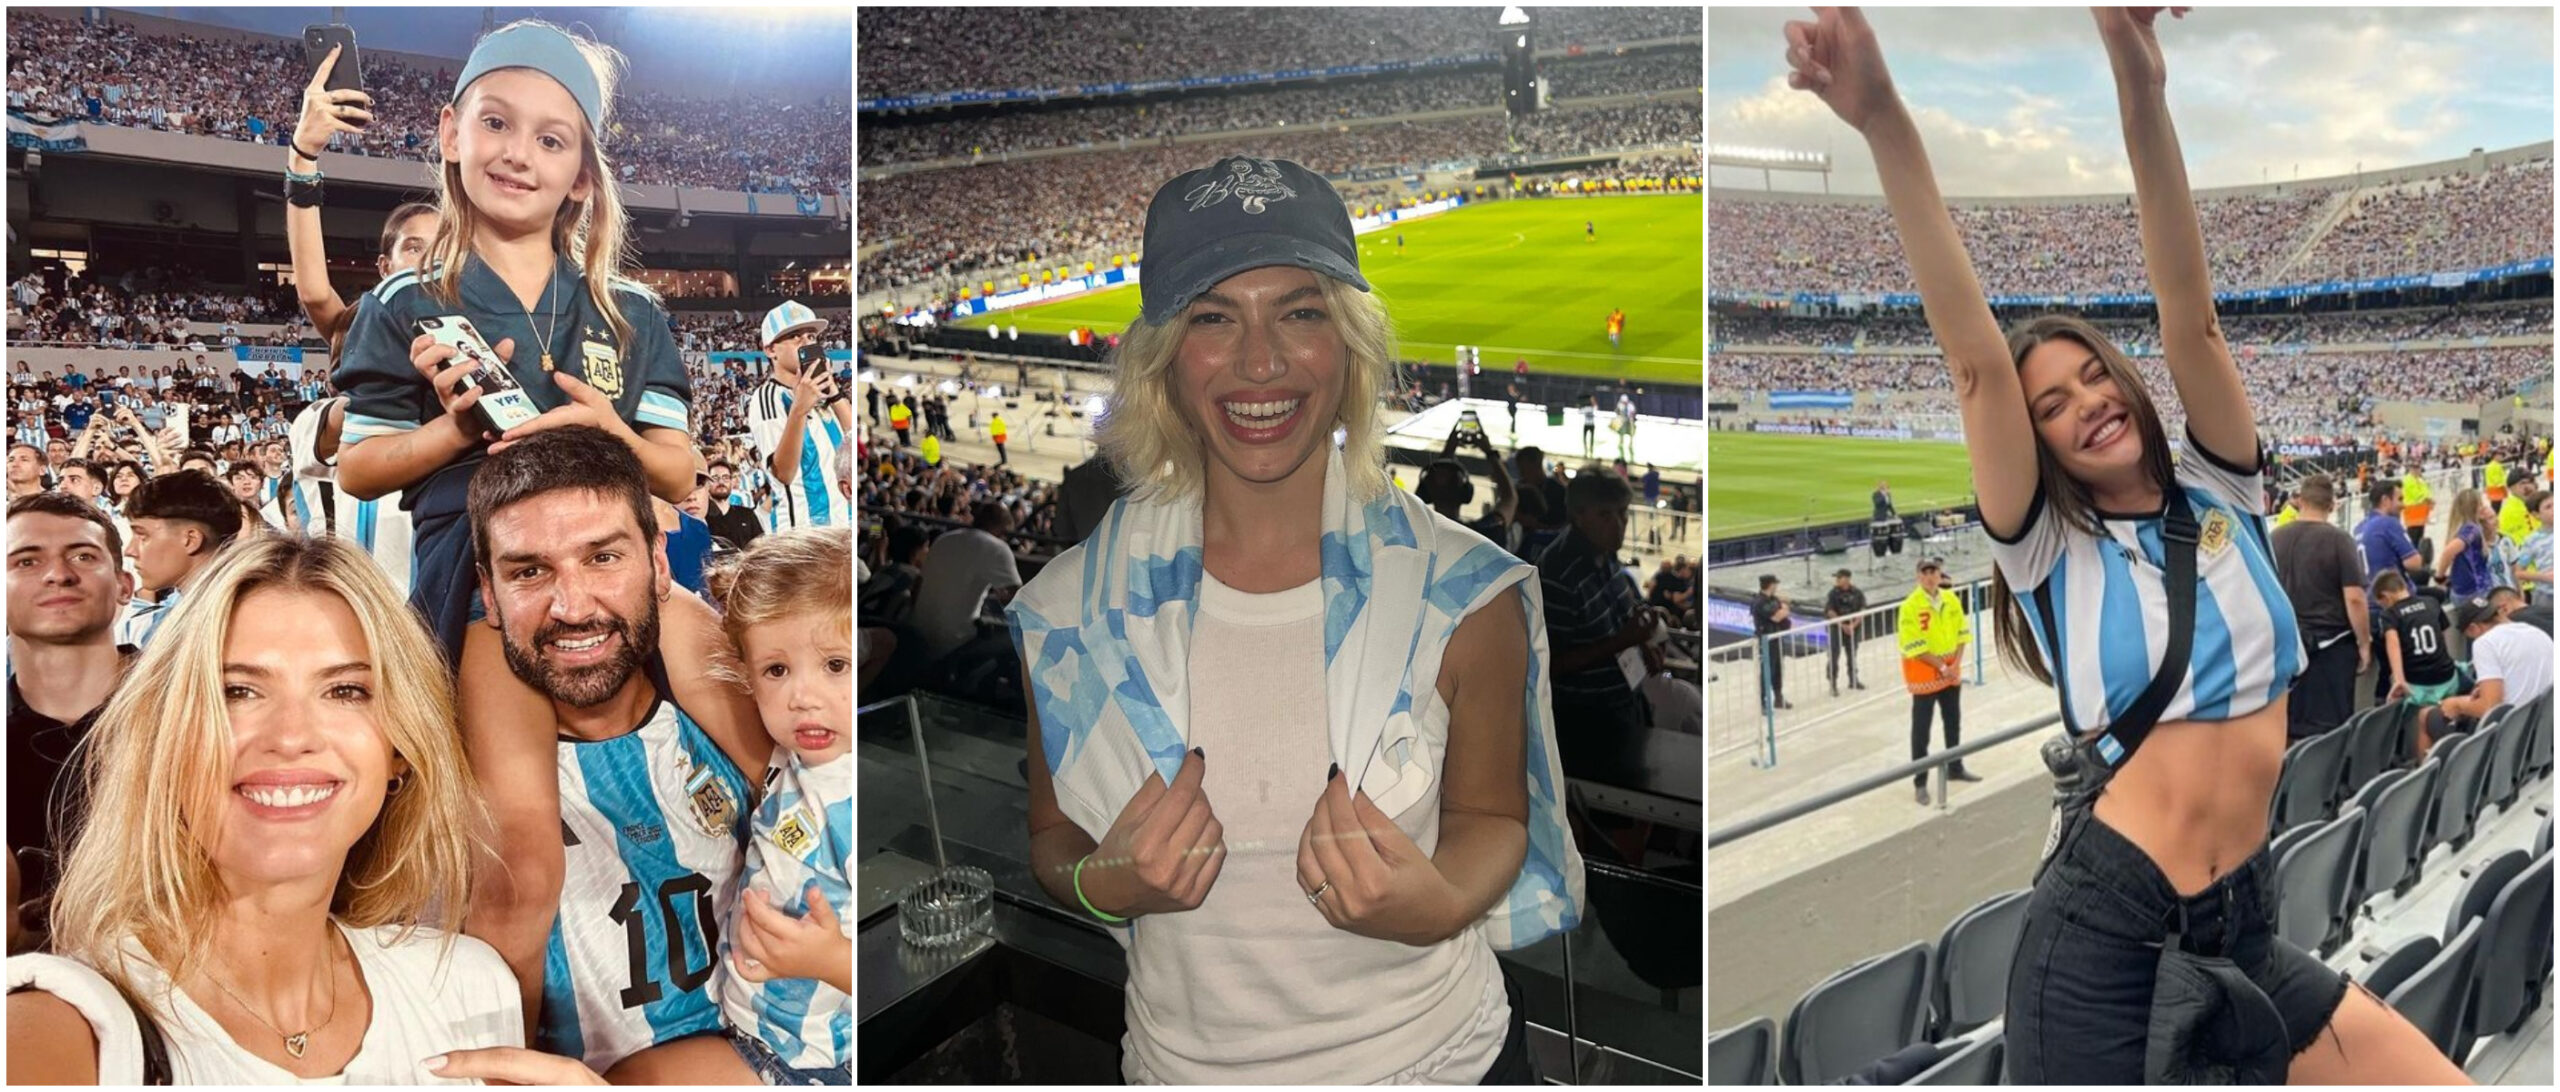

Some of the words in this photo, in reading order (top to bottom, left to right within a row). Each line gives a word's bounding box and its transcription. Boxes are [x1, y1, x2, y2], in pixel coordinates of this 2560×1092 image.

[494, 394, 521, 408] YPF
[2410, 624, 2438, 655] 10
[608, 872, 720, 1010] 10
